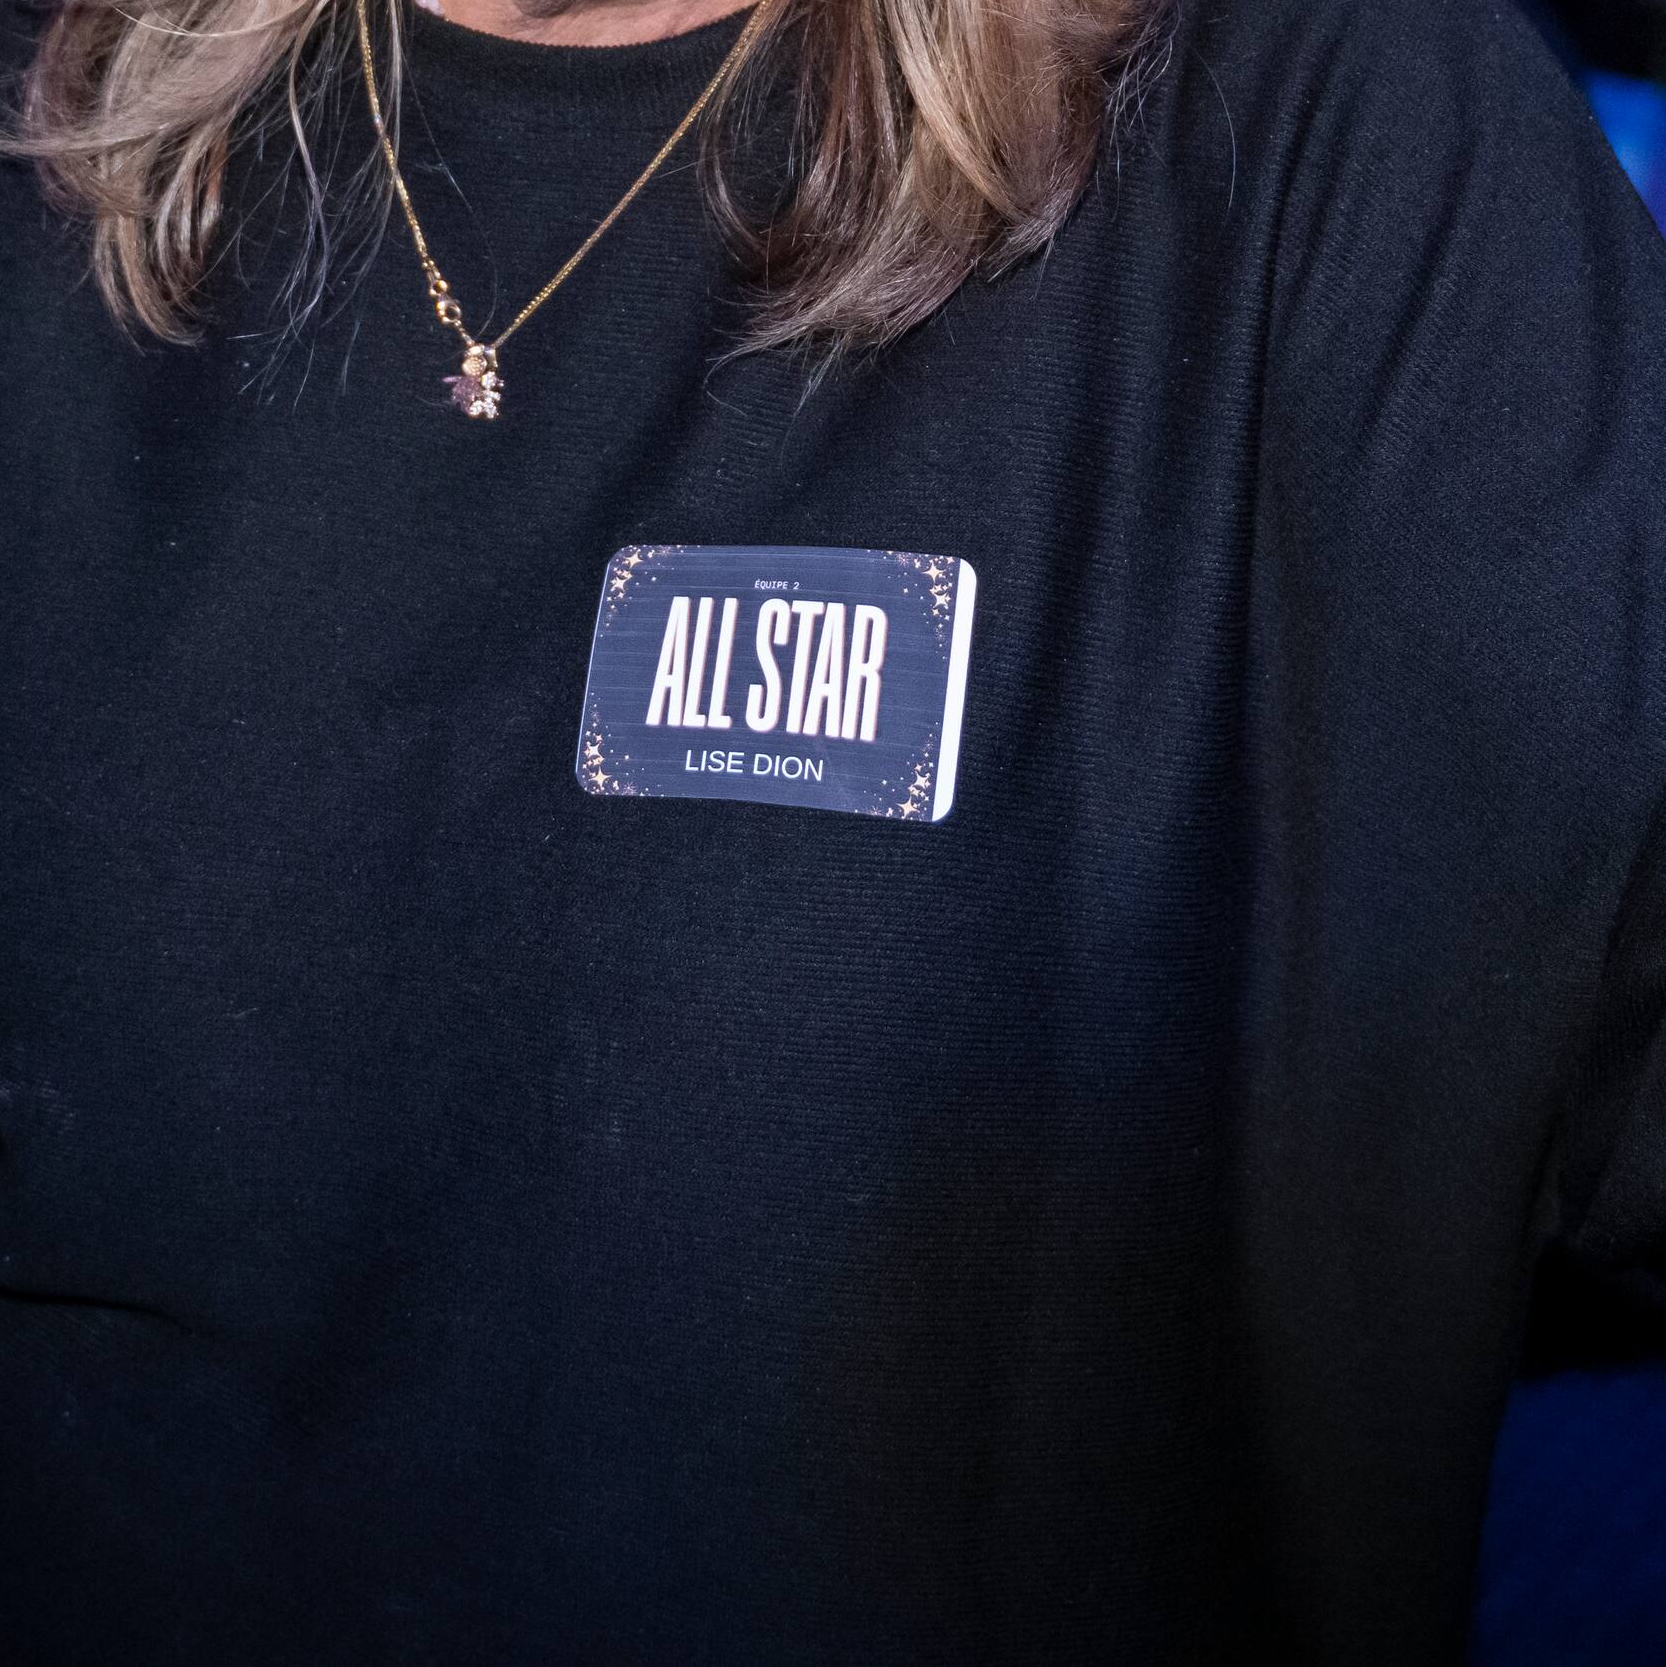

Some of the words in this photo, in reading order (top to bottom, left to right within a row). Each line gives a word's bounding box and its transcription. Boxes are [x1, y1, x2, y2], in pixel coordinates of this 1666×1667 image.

[754, 578, 789, 590] ÉQUIPE
[793, 581, 800, 590] 2
[645, 595, 739, 728] ALL
[745, 598, 888, 742] STAR
[685, 749, 745, 774] LISE
[753, 753, 824, 782] DION
